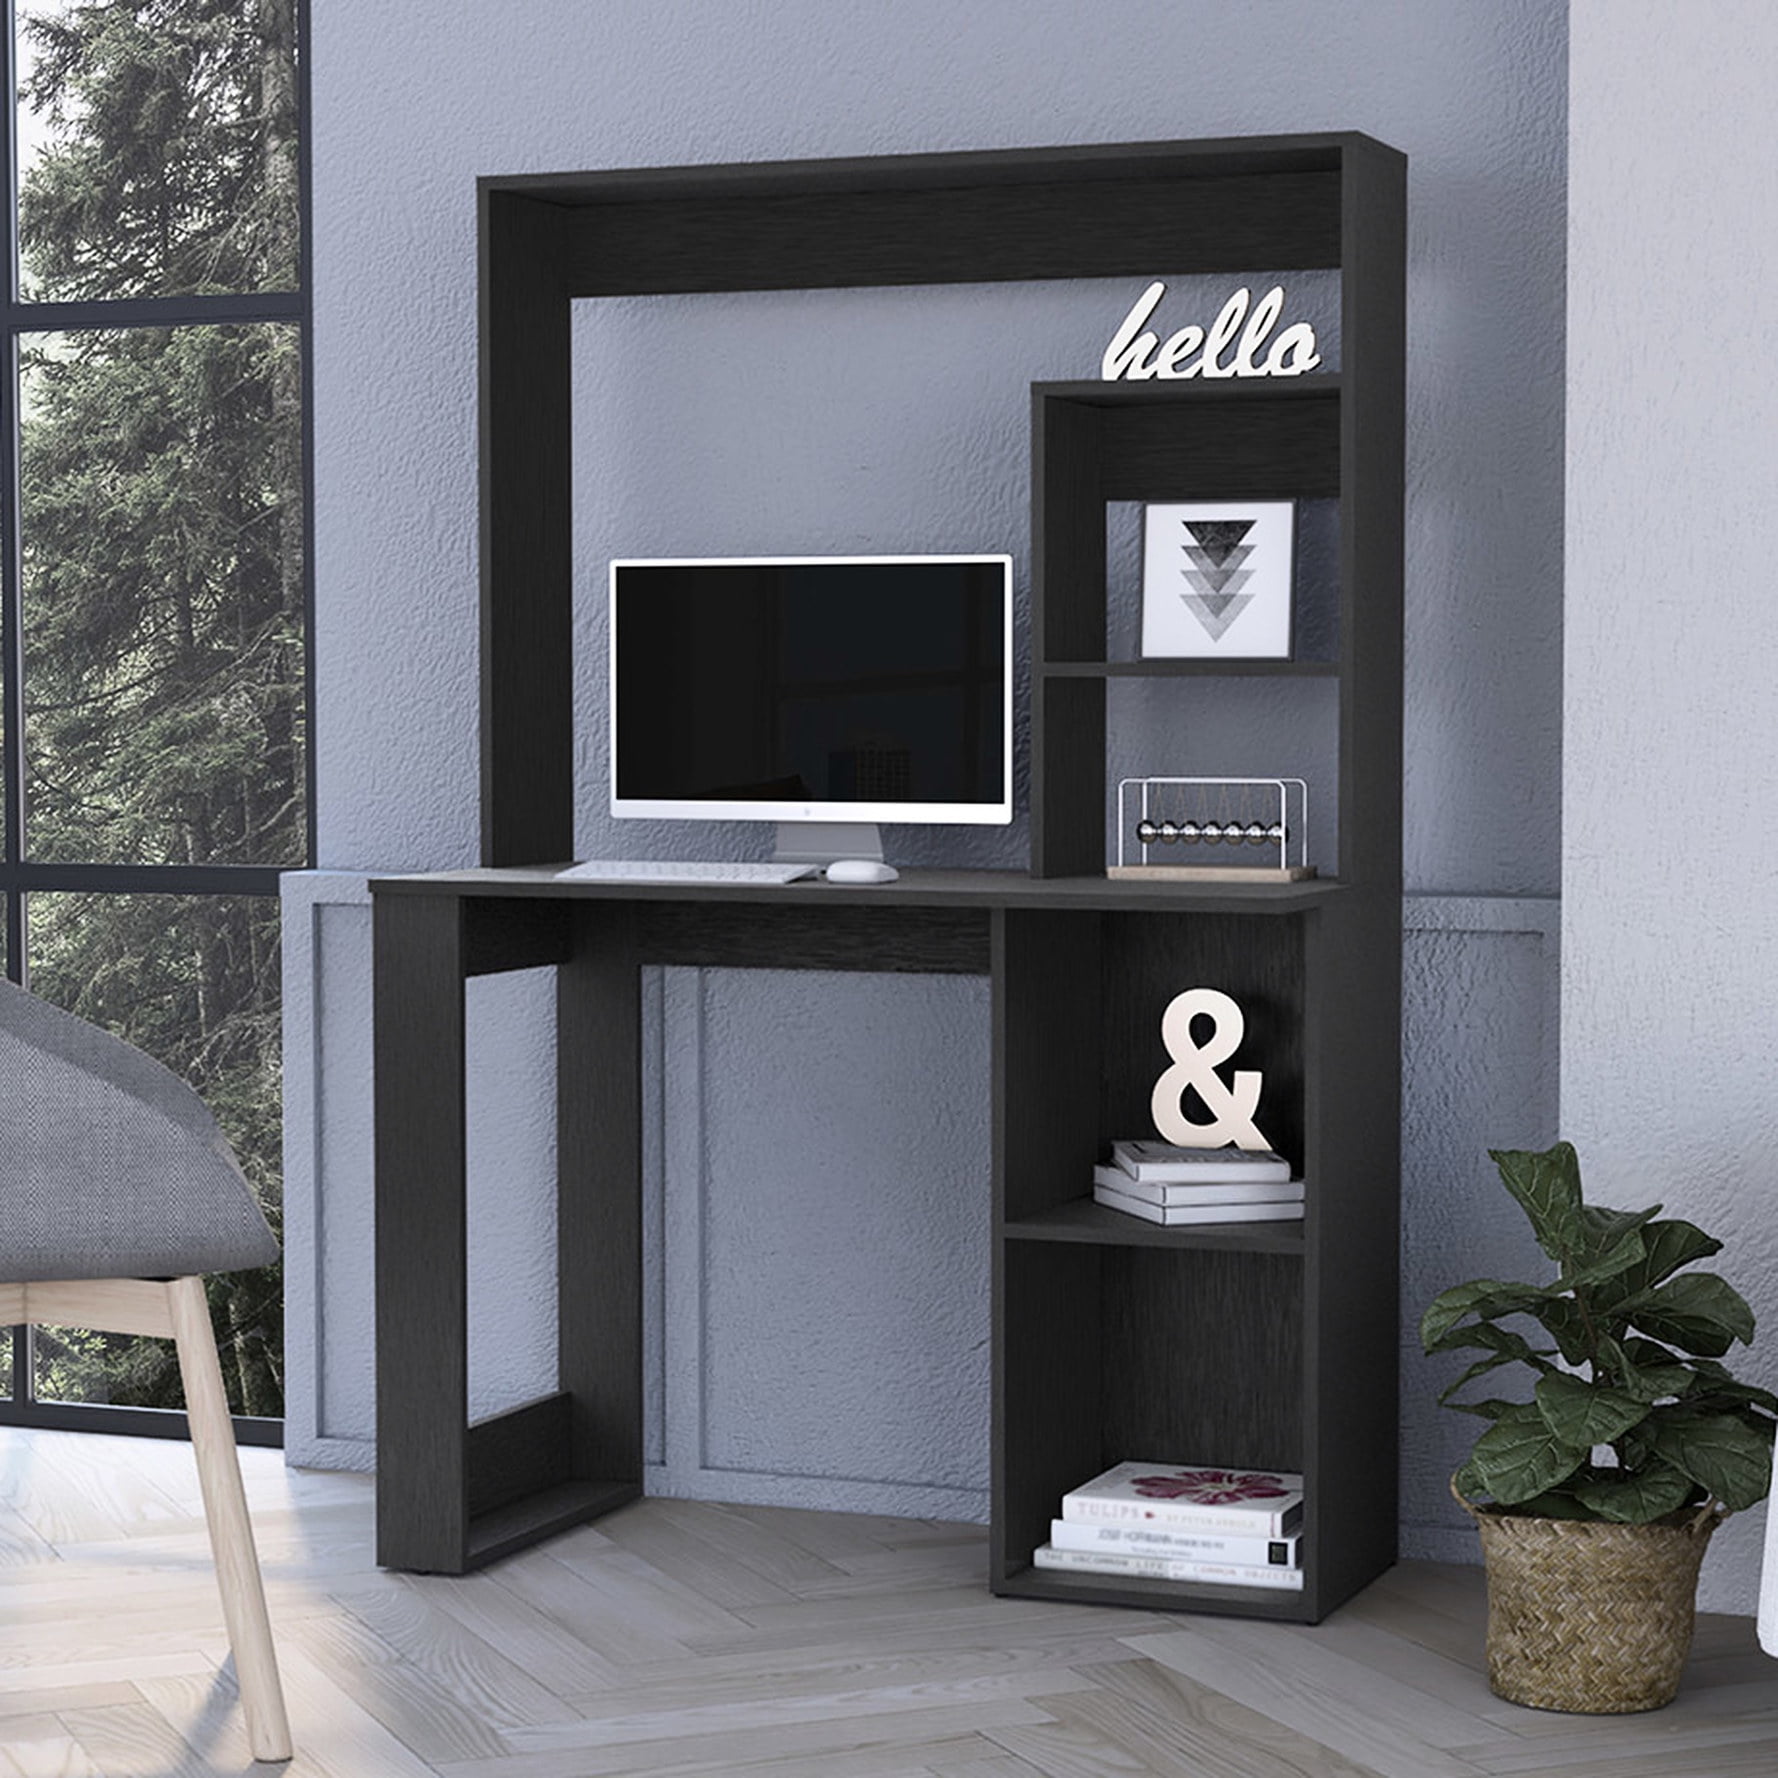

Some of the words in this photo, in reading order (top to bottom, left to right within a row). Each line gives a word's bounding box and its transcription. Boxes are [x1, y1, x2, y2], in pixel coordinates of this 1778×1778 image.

[1102, 281, 1321, 381] hello
[1151, 988, 1273, 1151] &
[1077, 1501, 1140, 1519] TULIPS
